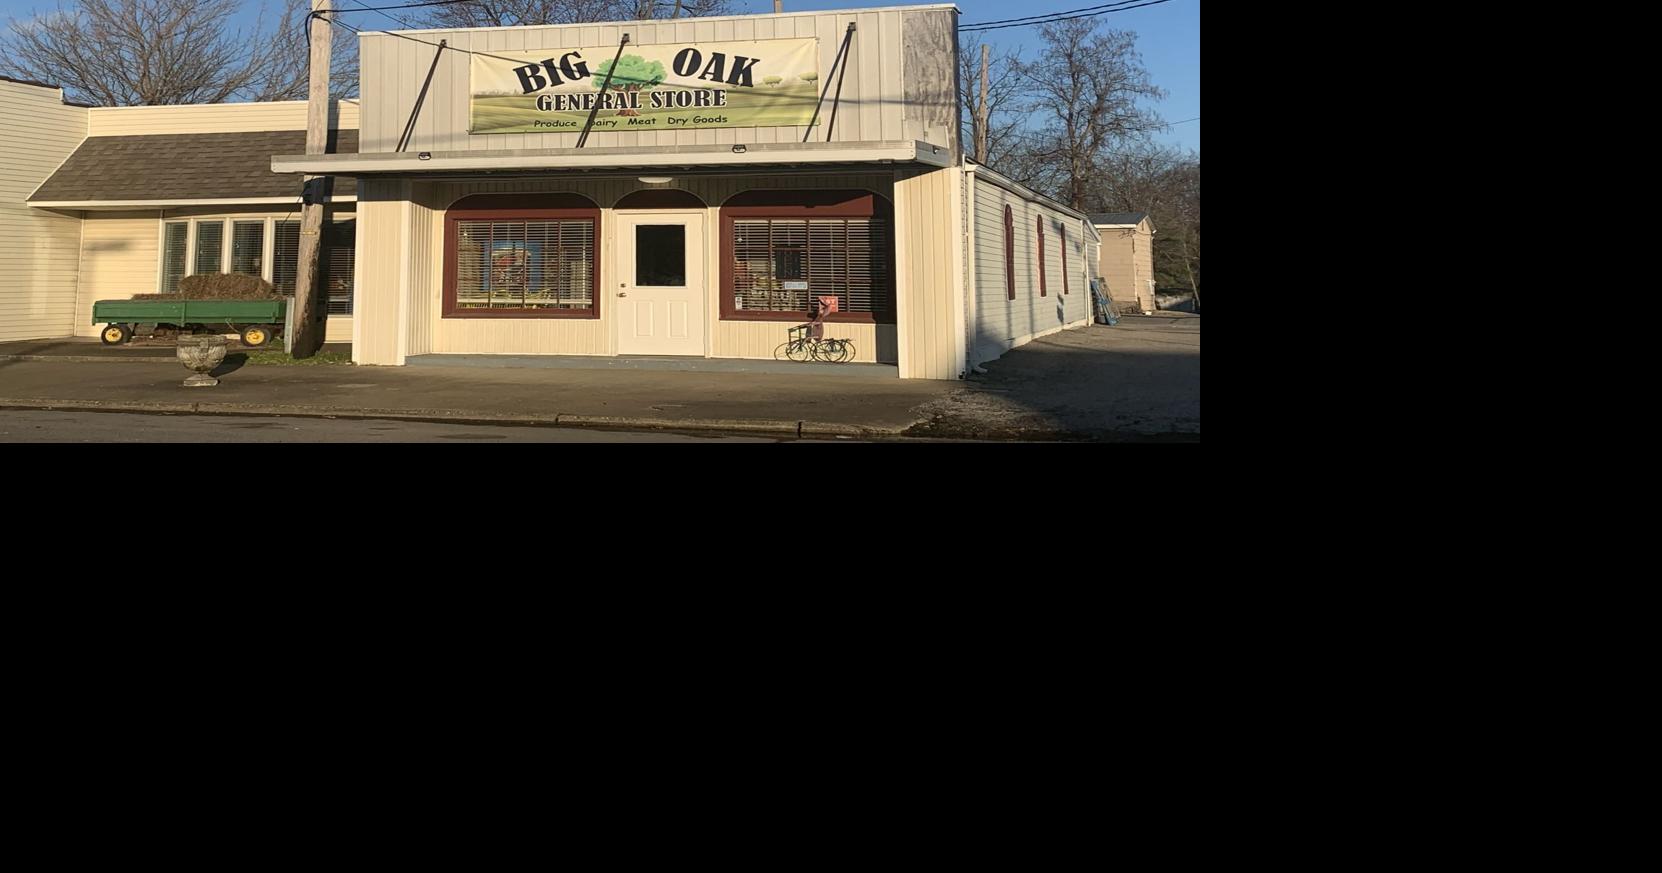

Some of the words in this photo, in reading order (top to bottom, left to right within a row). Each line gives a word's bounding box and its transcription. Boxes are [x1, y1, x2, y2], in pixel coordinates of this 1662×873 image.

[513, 51, 591, 95] BIG
[672, 47, 761, 87] OAK
[536, 91, 642, 112] GENERAL
[650, 89, 727, 109] STORE
[534, 120, 577, 129] Produce
[627, 116, 657, 126] Meat
[667, 116, 688, 127] Dry
[692, 114, 728, 124] Goods
